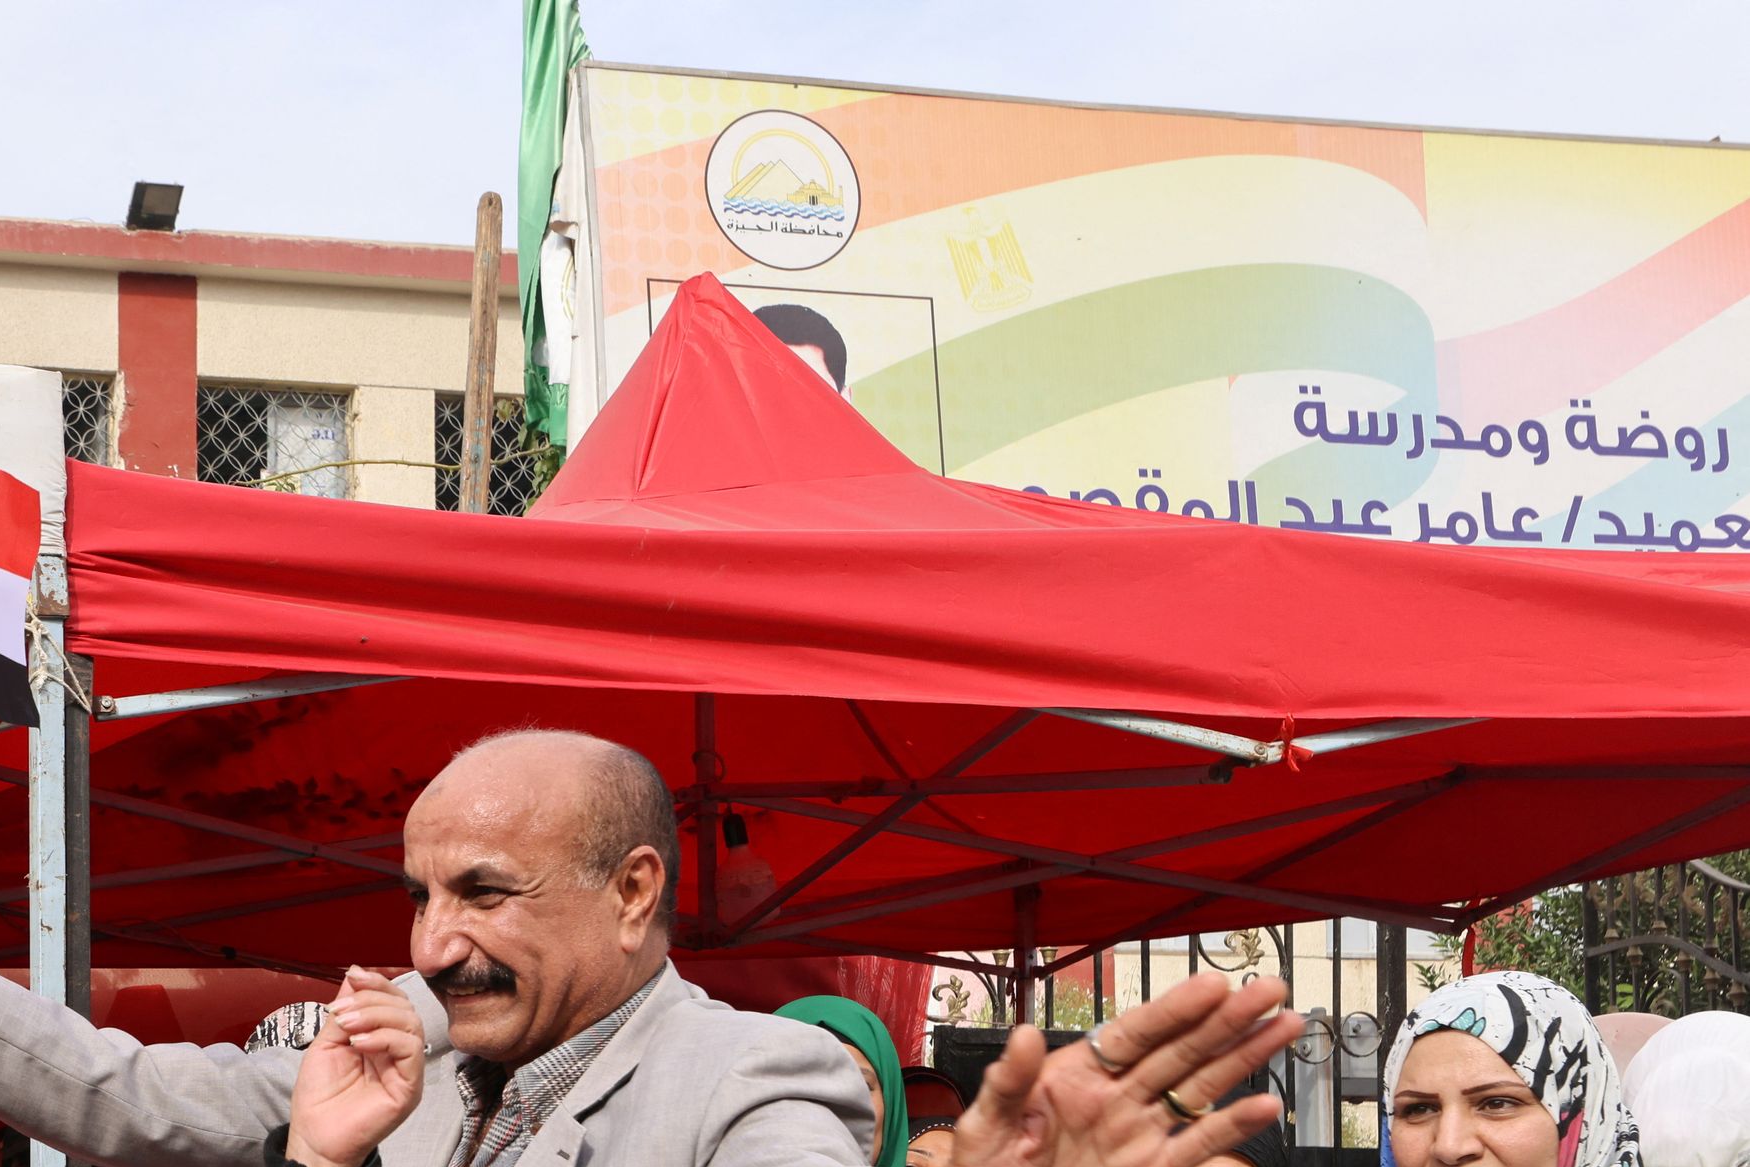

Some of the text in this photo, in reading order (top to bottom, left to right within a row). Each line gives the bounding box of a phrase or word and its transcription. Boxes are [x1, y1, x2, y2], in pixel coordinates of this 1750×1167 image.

[726, 218, 844, 239] محافظة الجيزة
[1293, 384, 1730, 473] روضة ومدرسة
